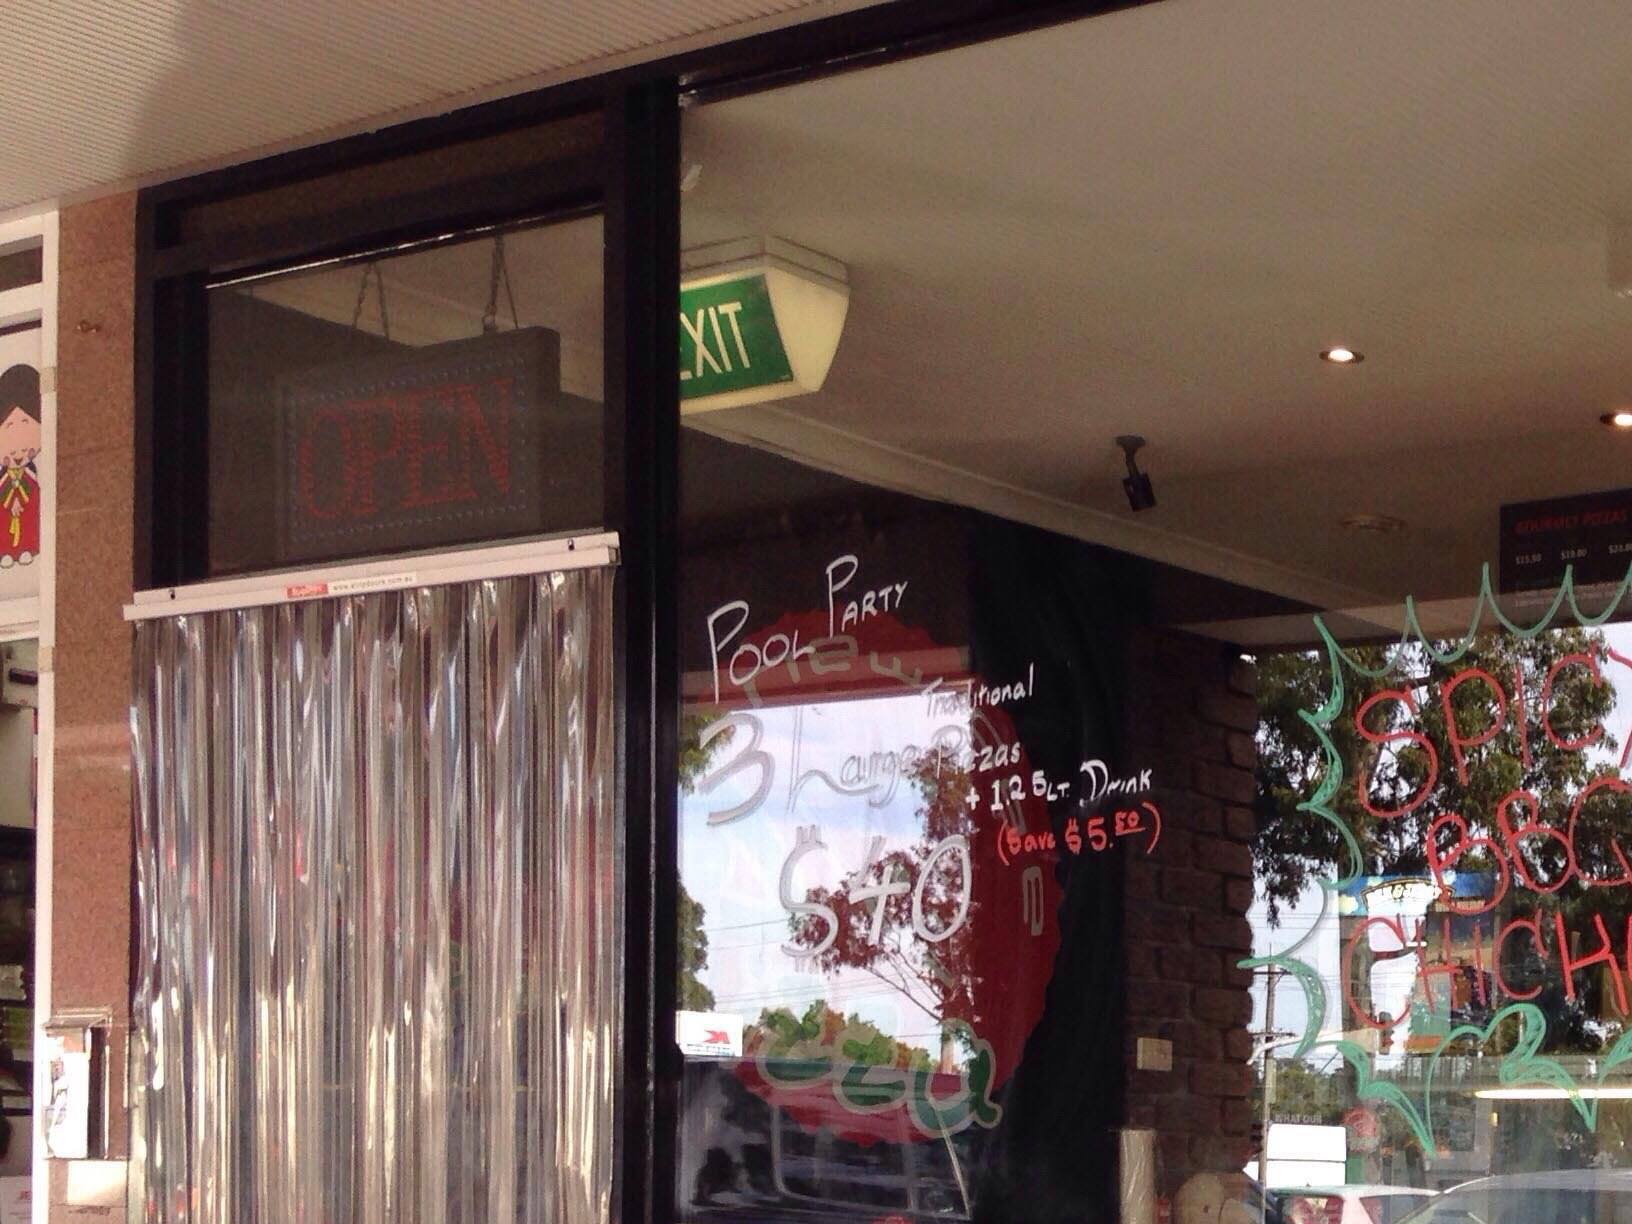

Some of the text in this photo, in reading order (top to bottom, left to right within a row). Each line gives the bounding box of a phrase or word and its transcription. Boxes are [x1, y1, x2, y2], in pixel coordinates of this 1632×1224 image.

[680, 301, 750, 380] XIT
[302, 381, 512, 516] OPEN
[697, 711, 776, 826] 3
[778, 823, 972, 962] $40
